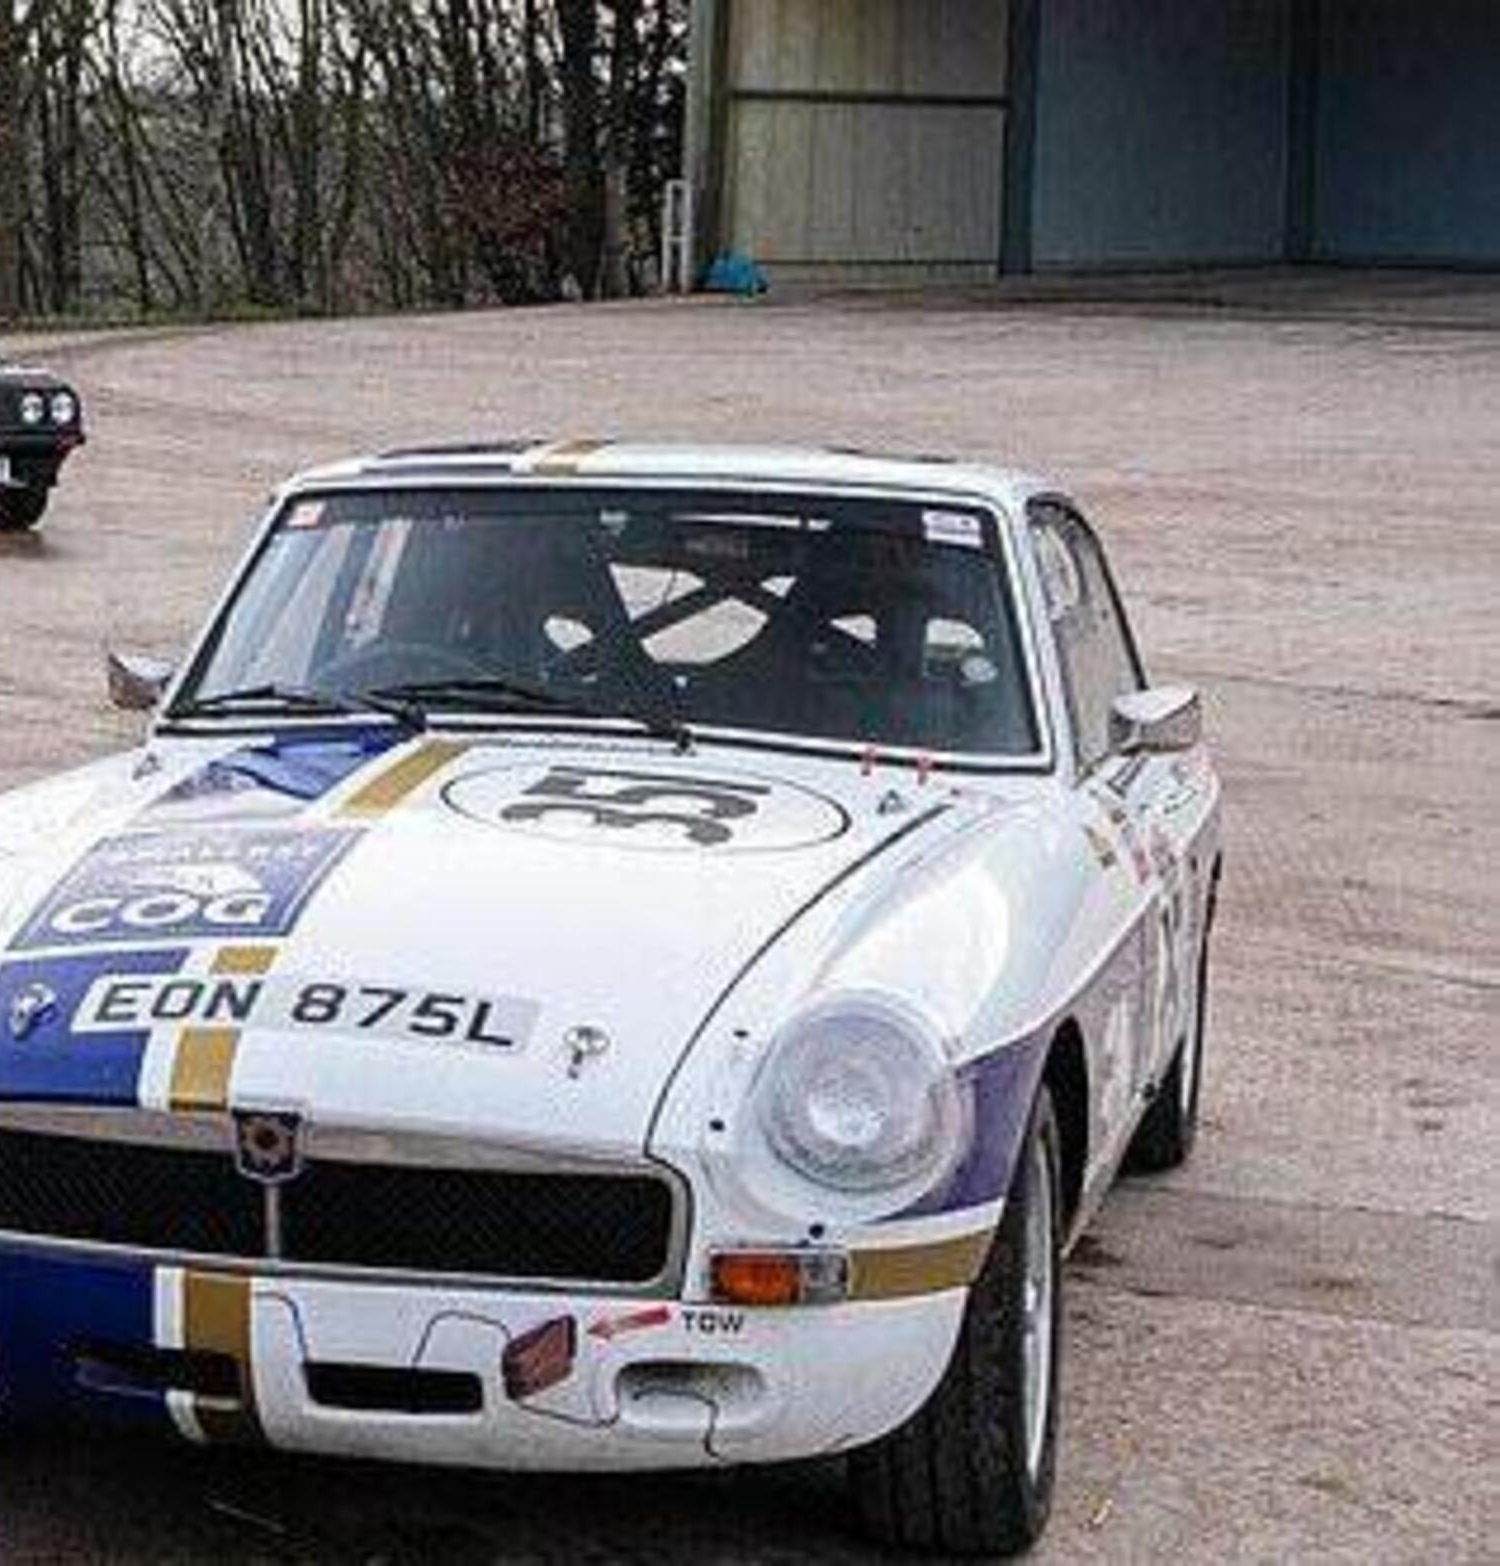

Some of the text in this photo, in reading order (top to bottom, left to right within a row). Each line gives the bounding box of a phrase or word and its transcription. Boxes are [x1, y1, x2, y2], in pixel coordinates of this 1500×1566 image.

[51, 892, 270, 933] COG
[93, 979, 513, 1047] EON 875L
